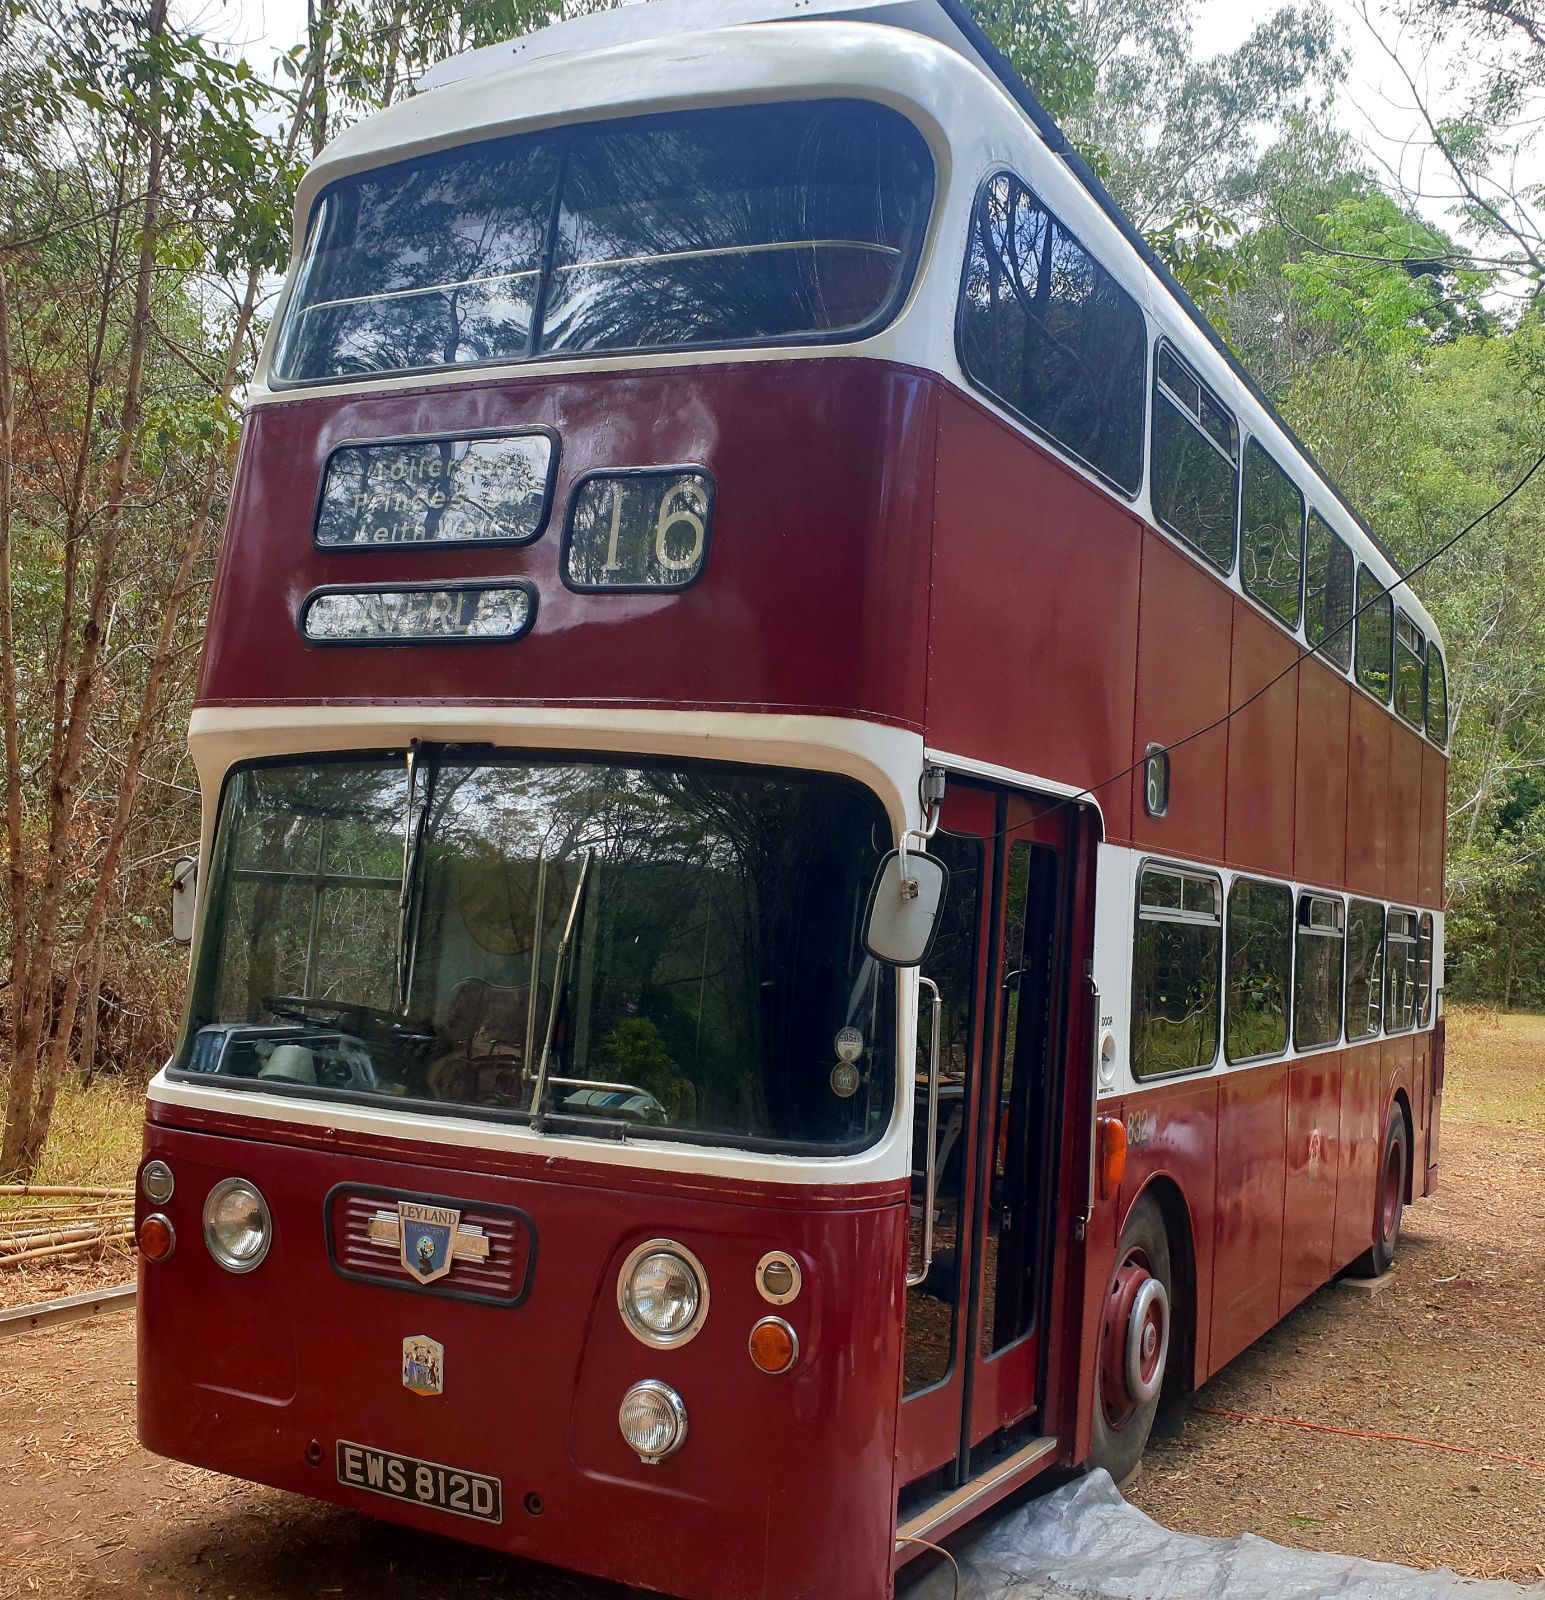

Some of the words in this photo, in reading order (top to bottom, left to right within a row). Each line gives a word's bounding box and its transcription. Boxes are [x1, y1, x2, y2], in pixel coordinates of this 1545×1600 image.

[601, 480, 707, 570] 16
[1147, 759, 1157, 811] 6
[1101, 1016, 1113, 1026] DOOR
[1127, 1109, 1149, 1145] 832
[400, 1204, 457, 1225] LEYLAND
[344, 1447, 407, 1493] EWS
[415, 1467, 493, 1515] 812D
